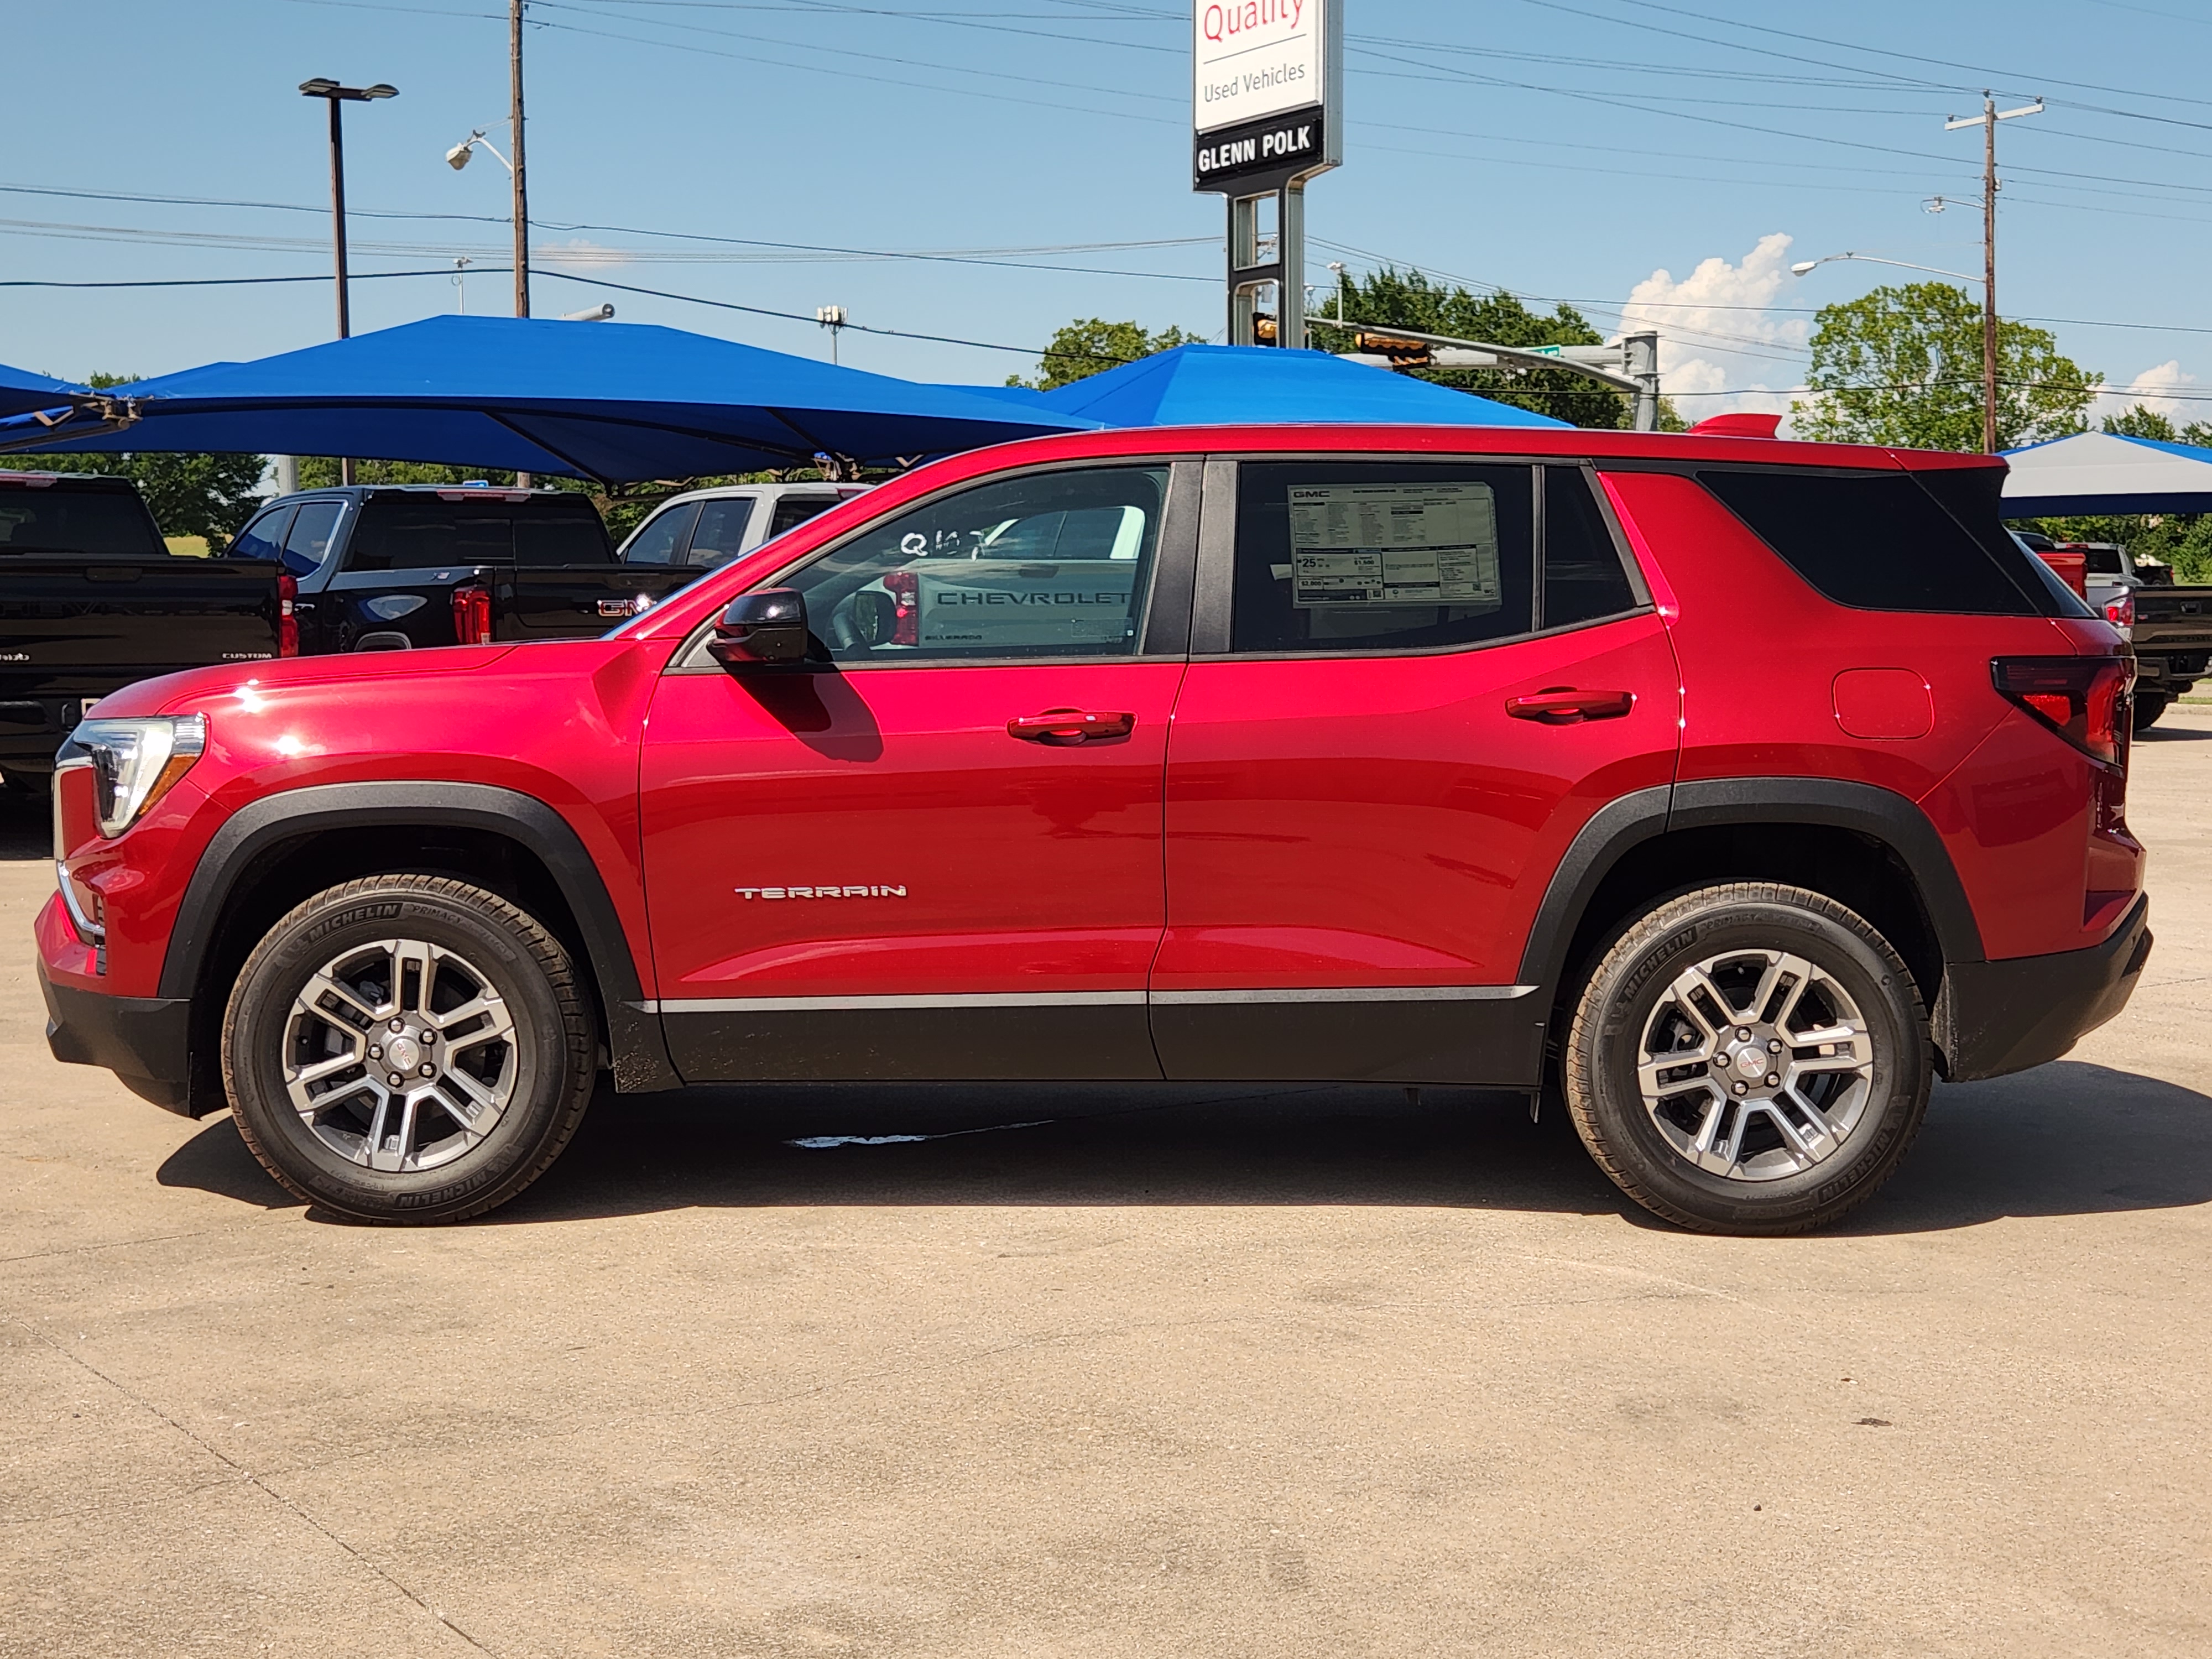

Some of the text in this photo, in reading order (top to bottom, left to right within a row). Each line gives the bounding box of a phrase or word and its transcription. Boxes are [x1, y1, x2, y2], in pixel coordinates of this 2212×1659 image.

[1204, 0, 1303, 42] Quality
[1204, 64, 1306, 102] Used Vehicles
[1198, 126, 1311, 173] GLENN POLK
[1302, 557, 1317, 568] 25
[937, 592, 1133, 605] CHEVROLET
[734, 884, 907, 900] TERRAIN
[309, 904, 462, 941] MICHELIN PRIMACY
[1624, 929, 1694, 999] MICHELIN
[1740, 1057, 1764, 1068] GMC
[1820, 1131, 1891, 1201] MICHELIN
[400, 1170, 488, 1208] MICHELIN
